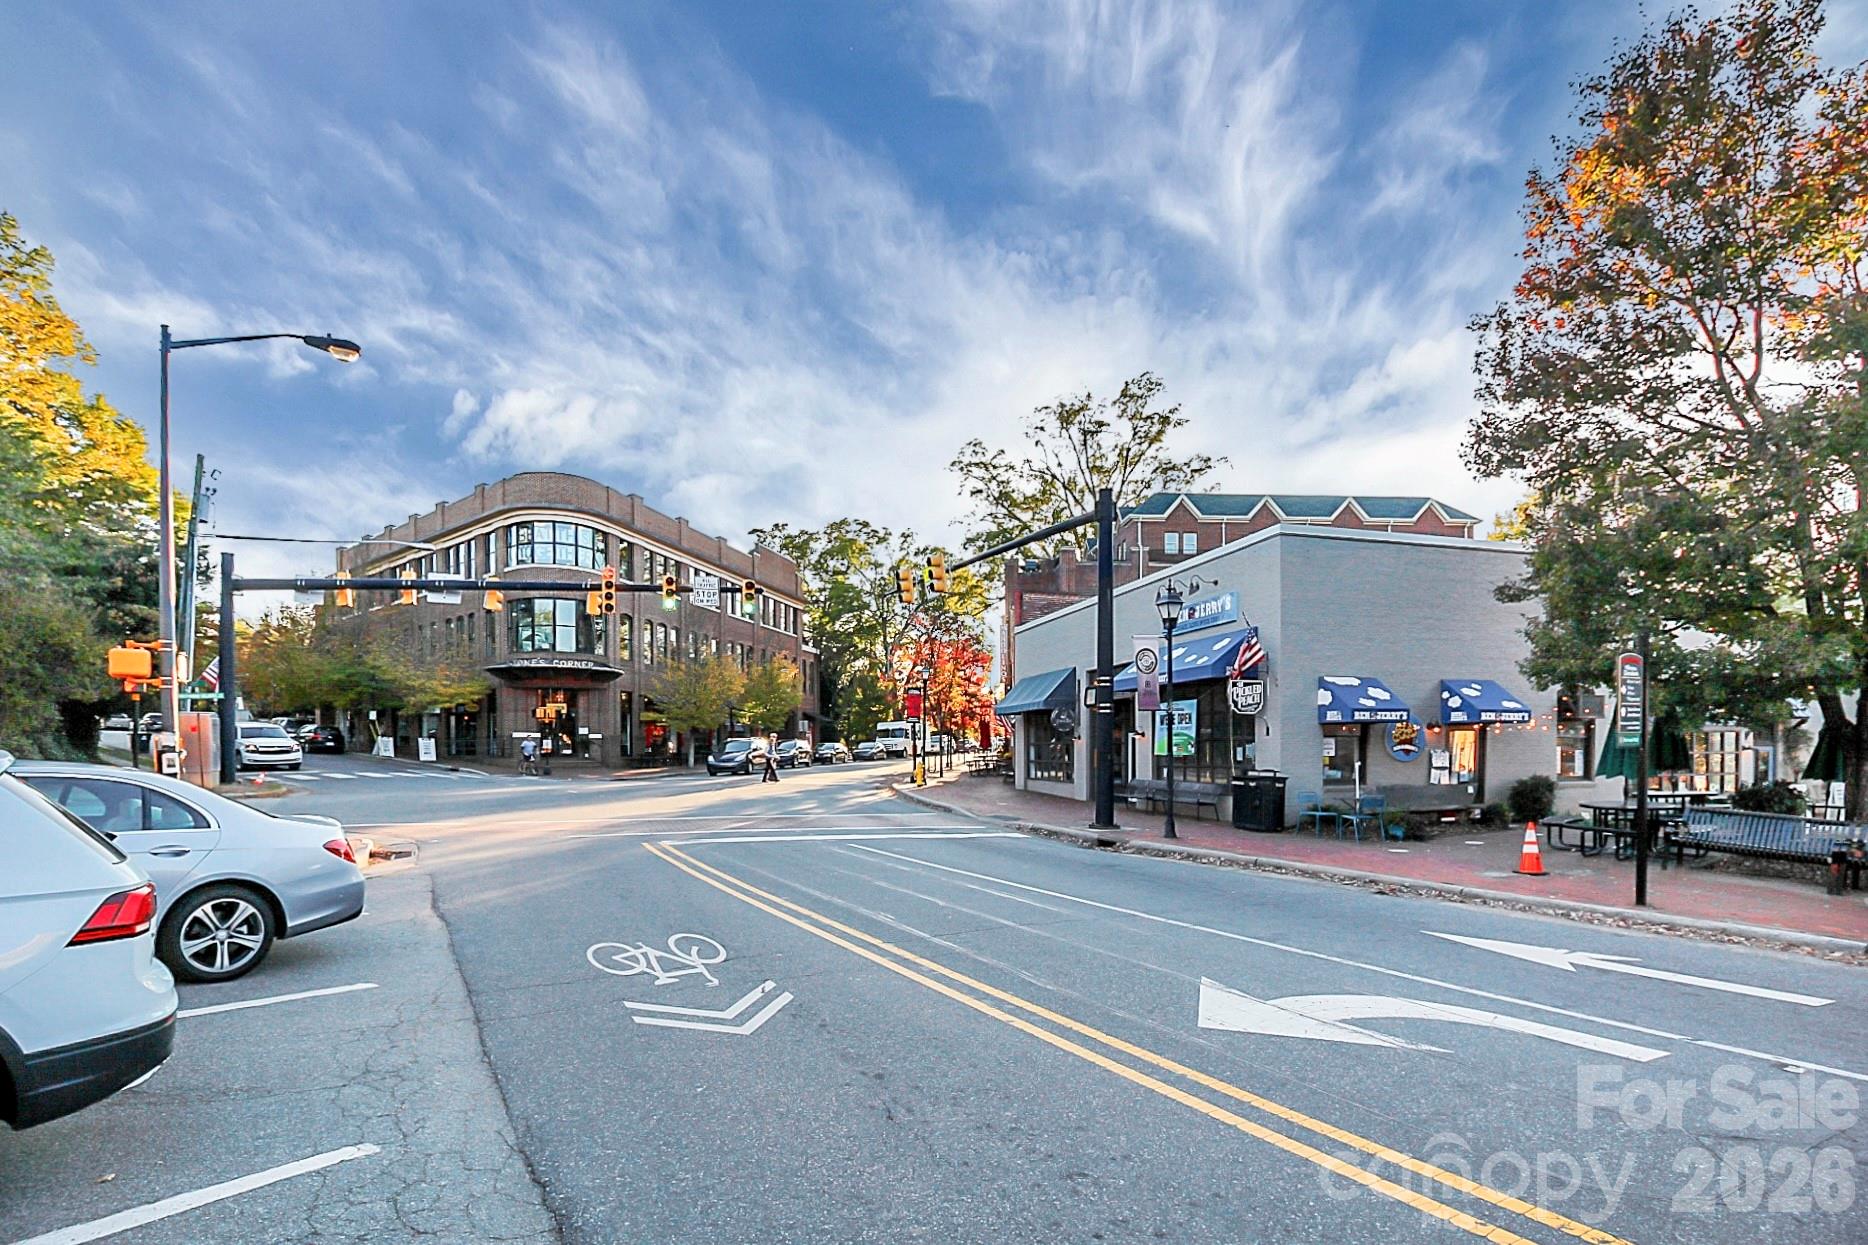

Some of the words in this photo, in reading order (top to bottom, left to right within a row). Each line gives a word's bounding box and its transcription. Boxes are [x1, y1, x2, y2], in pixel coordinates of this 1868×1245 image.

[696, 590, 718, 599] STOP
[1196, 595, 1232, 618] JERRY'S
[552, 659, 594, 669] CORNER
